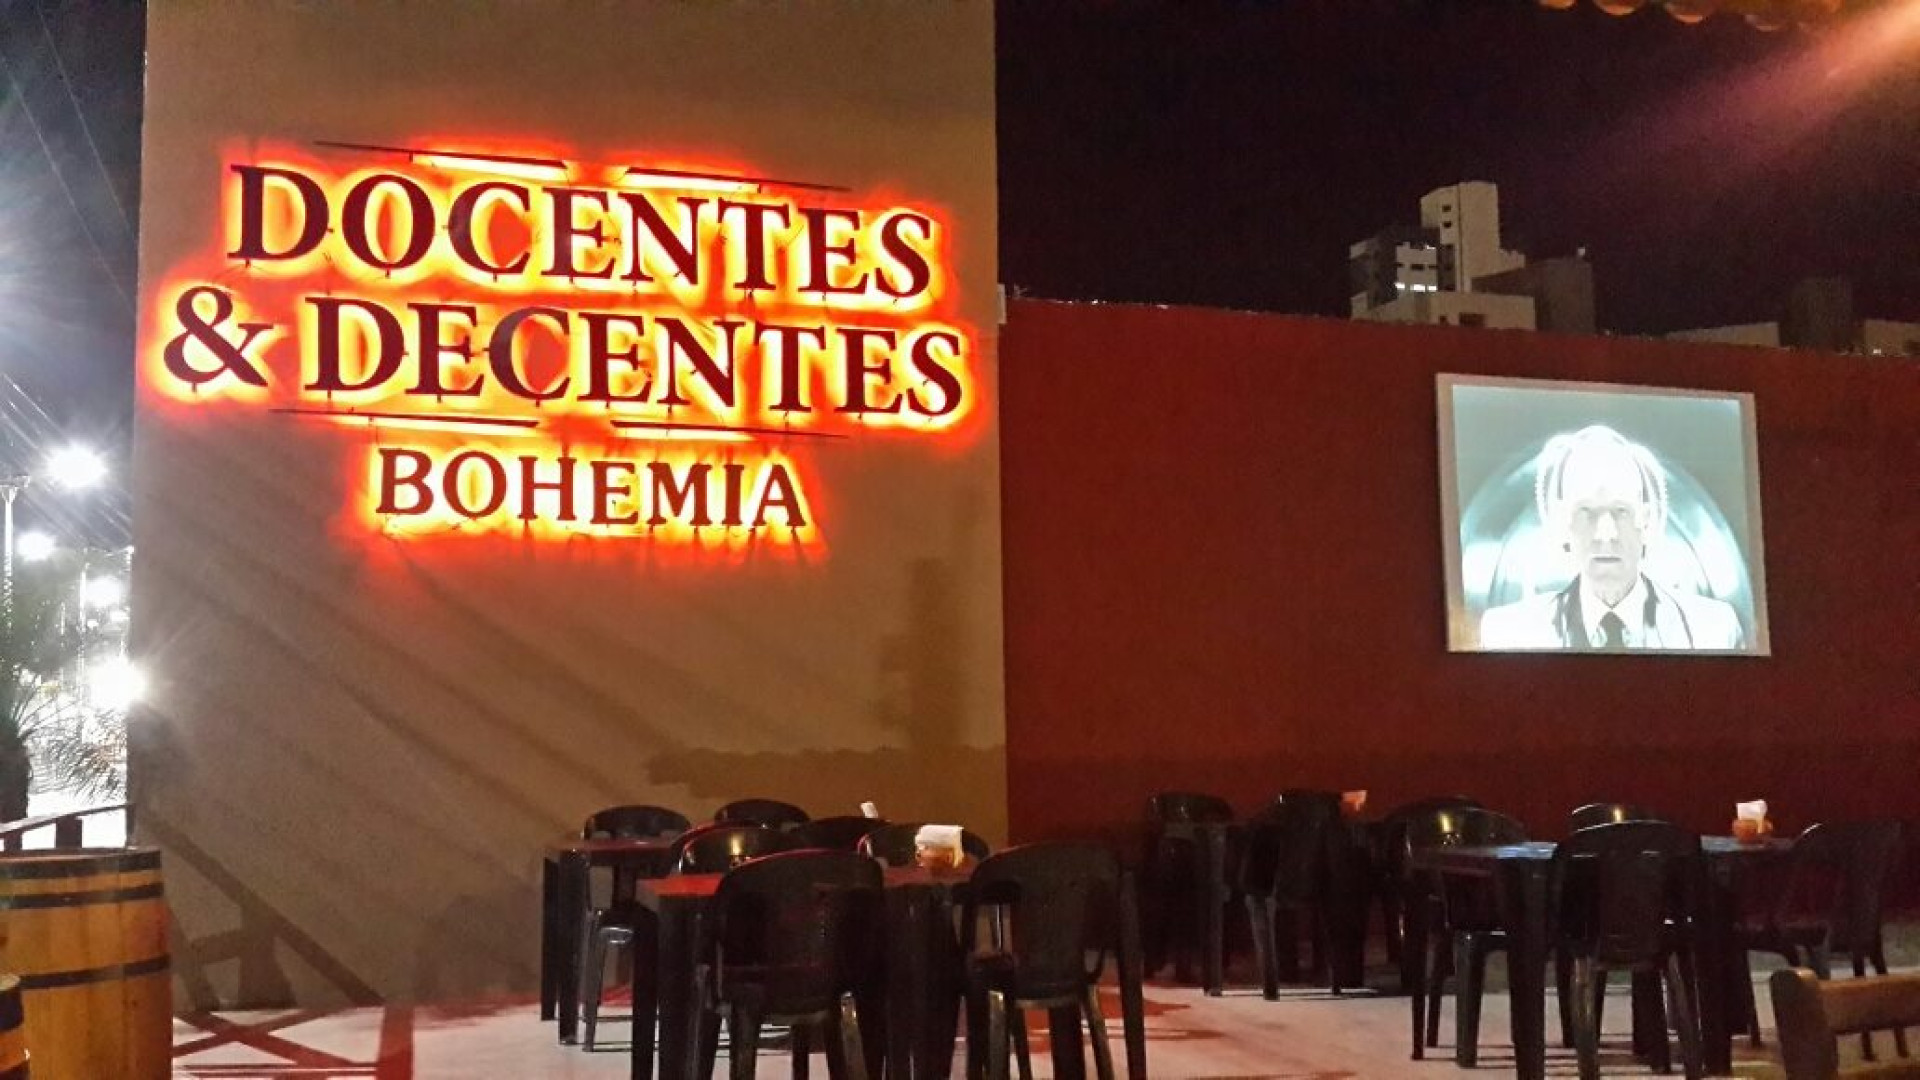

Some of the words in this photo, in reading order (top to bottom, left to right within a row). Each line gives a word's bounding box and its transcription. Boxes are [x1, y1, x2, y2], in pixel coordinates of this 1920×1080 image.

[227, 163, 932, 299] DOCENTES
[162, 286, 273, 386] &
[304, 296, 963, 419] DECENTES
[375, 447, 806, 528] BOHEMIA
